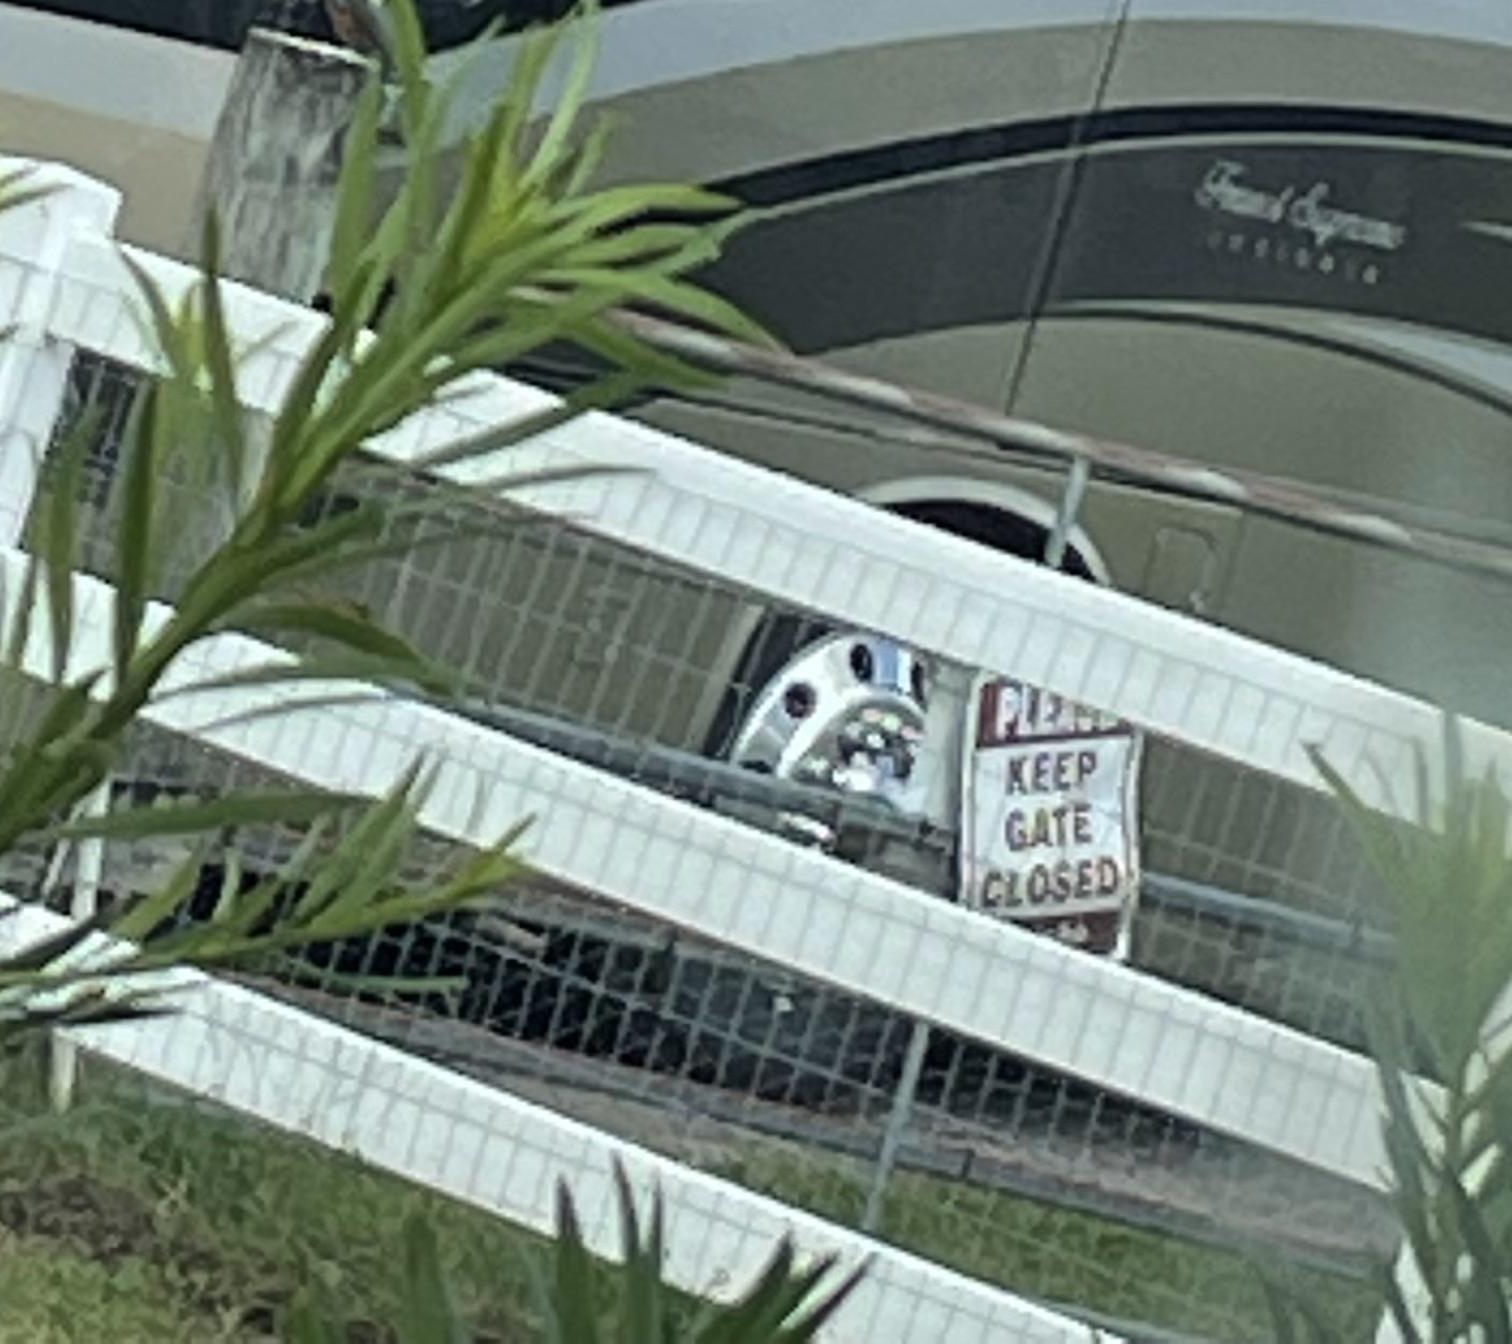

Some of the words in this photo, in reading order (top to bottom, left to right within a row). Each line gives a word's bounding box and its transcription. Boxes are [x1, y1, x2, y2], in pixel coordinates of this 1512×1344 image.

[1006, 751, 1096, 795] KEEP
[1005, 804, 1093, 851] GATE
[982, 856, 1119, 908] CLOSED
